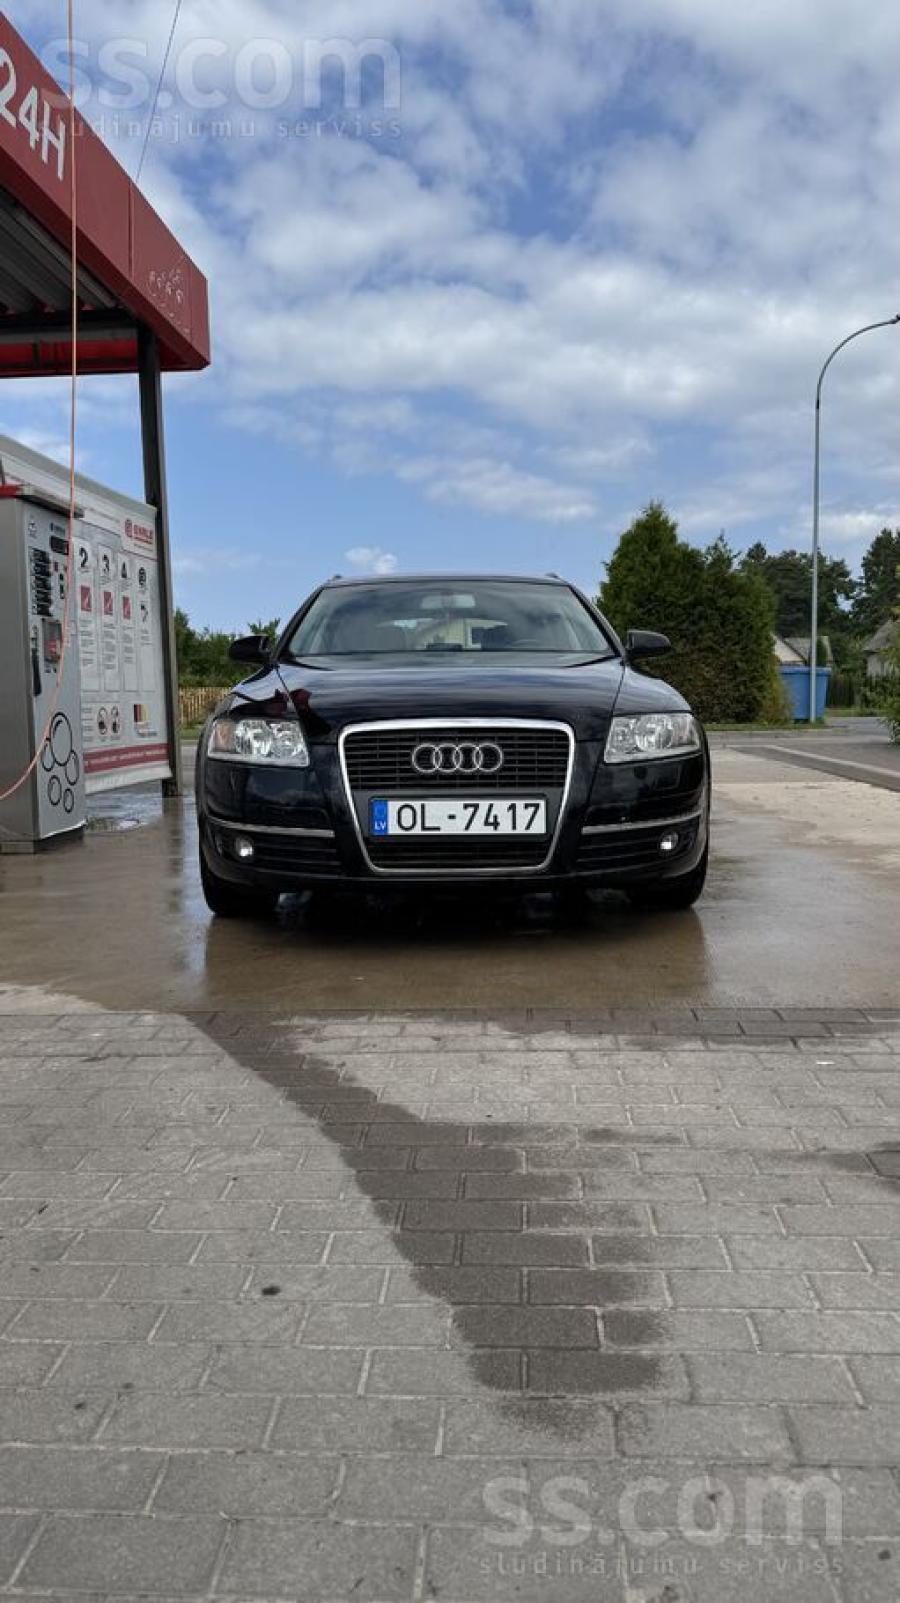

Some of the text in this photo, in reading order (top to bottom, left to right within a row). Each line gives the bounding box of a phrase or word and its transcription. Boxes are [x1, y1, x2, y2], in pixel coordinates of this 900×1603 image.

[0, 47, 66, 181] 24H
[79, 547, 88, 568] 2
[103, 554, 110, 574] 3
[374, 803, 540, 832] LV OL-7417
